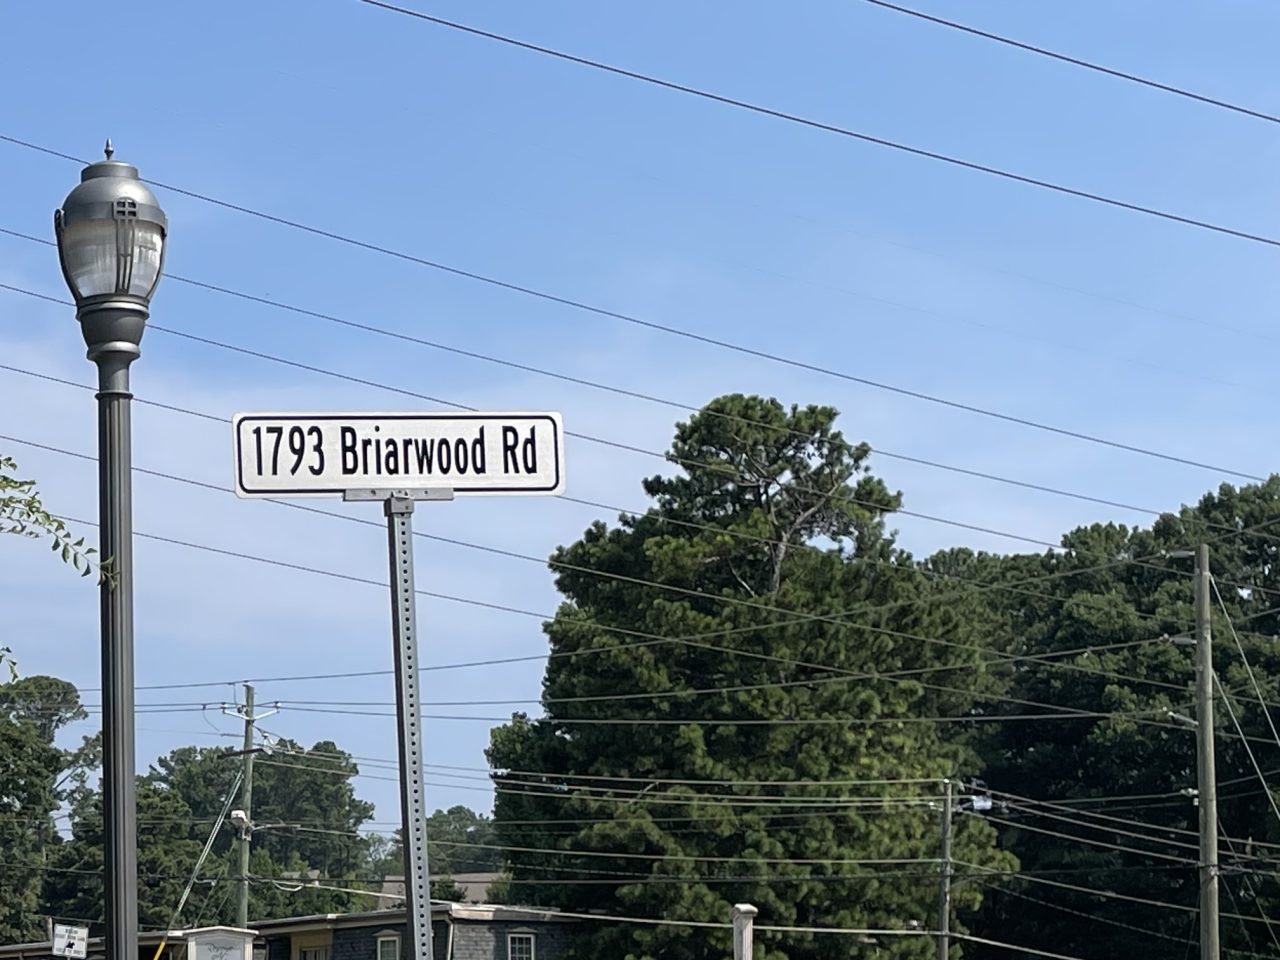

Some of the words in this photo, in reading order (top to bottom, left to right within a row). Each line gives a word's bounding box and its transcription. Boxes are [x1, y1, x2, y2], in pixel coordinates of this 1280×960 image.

[252, 425, 325, 476] 1793
[340, 425, 486, 476] Briarwood
[502, 425, 538, 475] Rd
